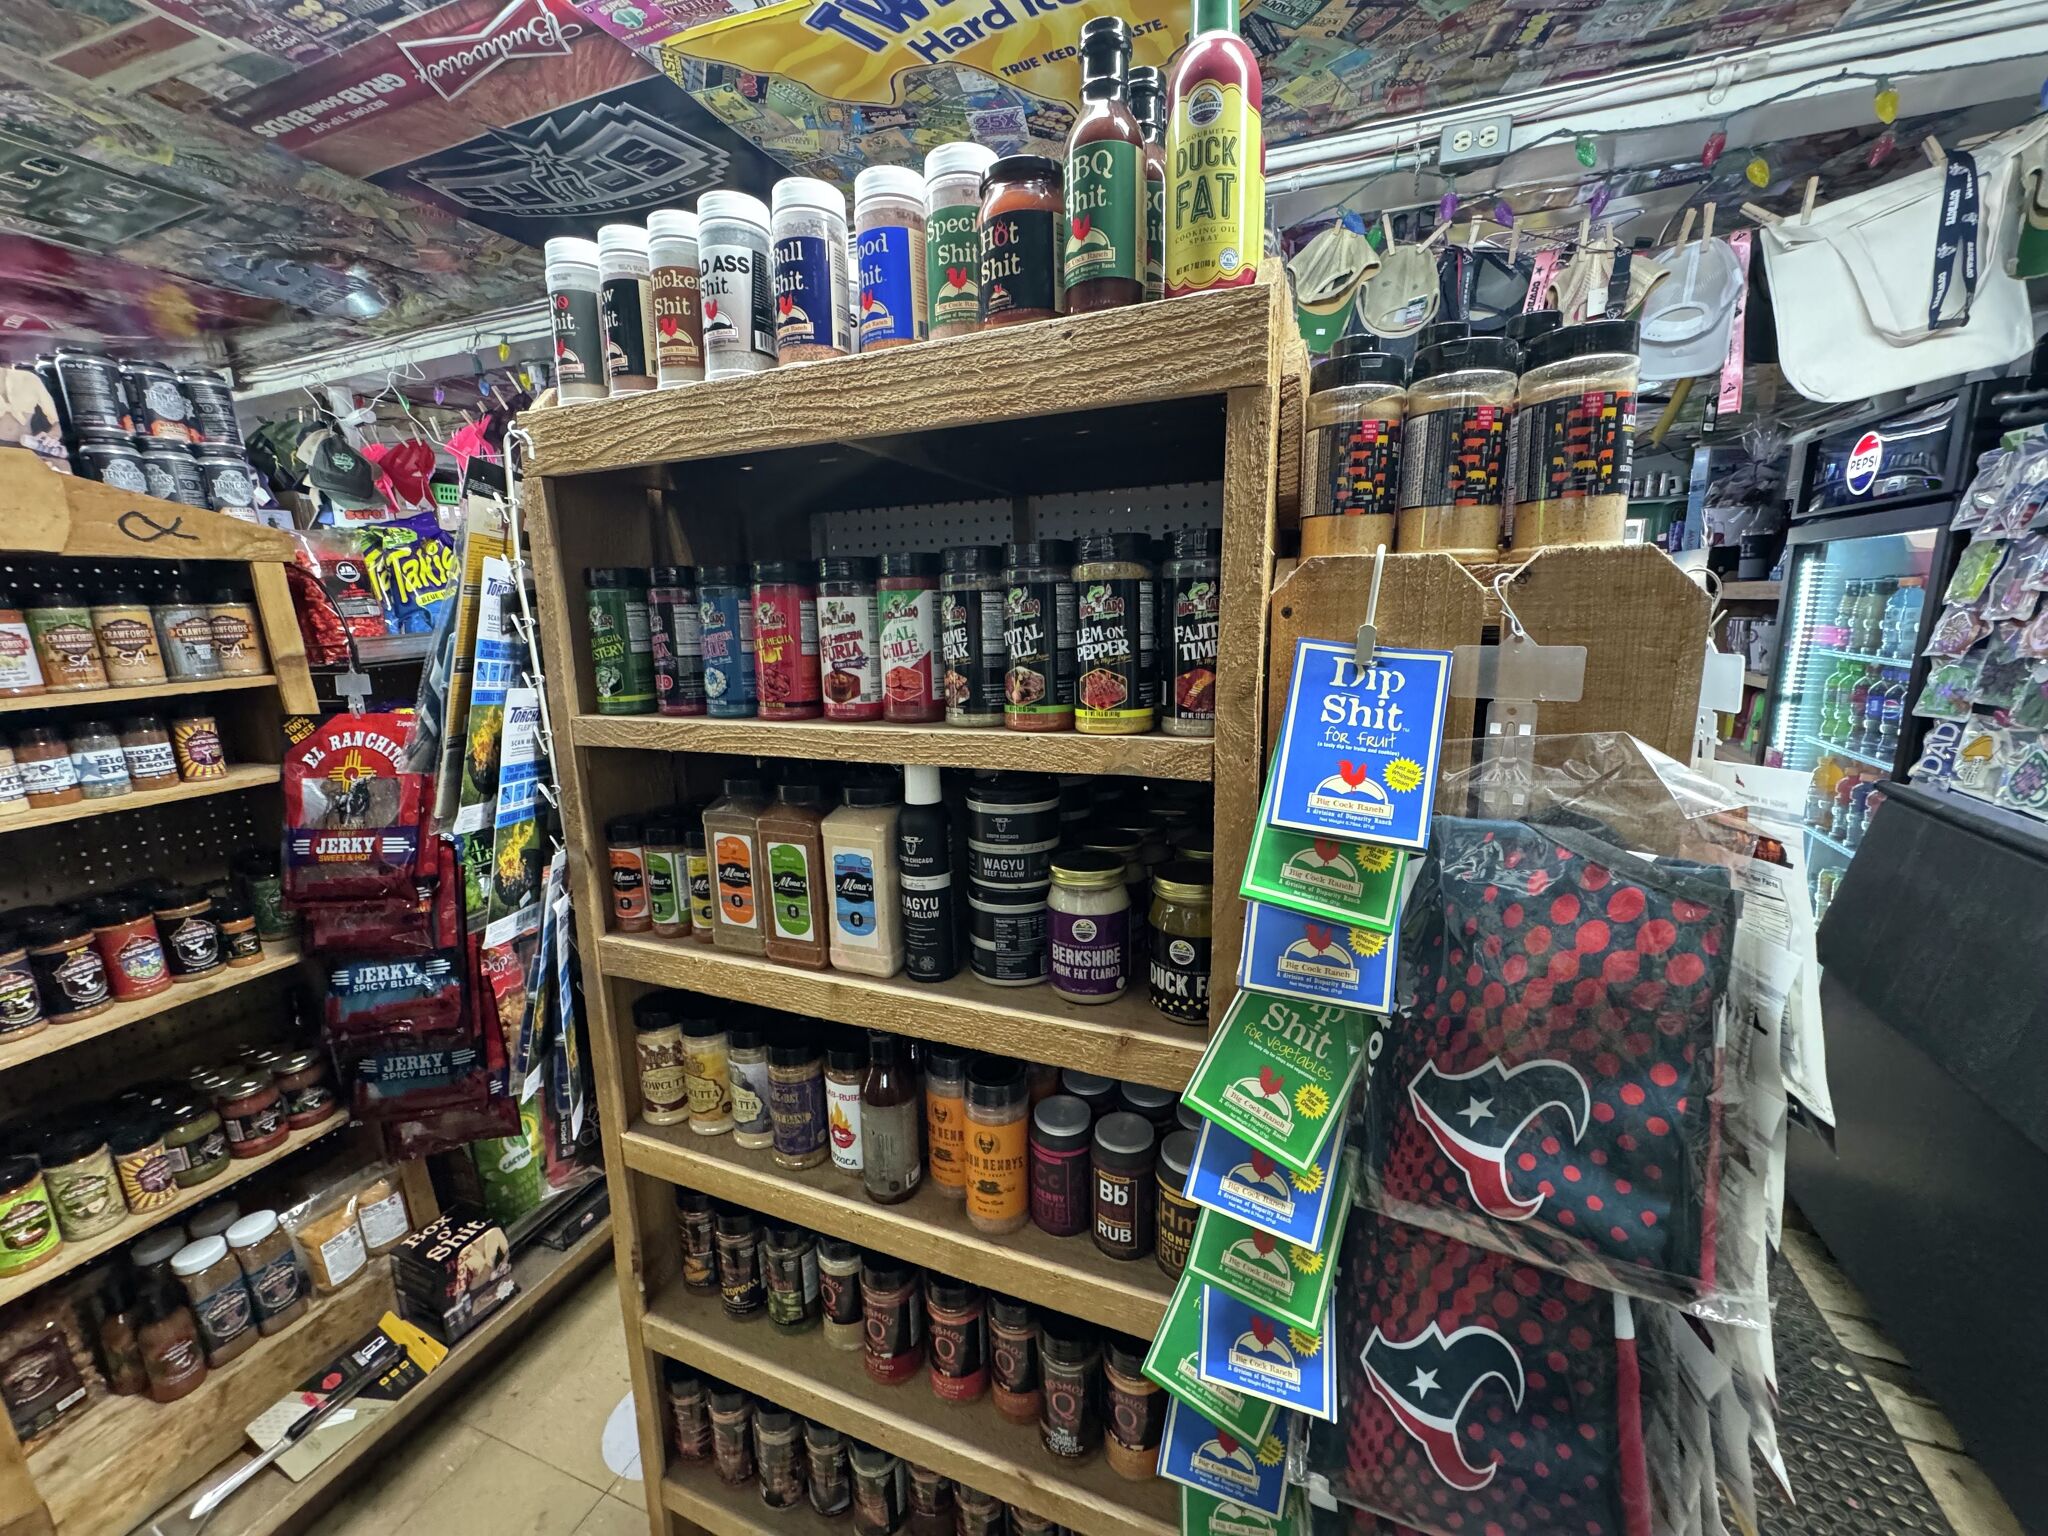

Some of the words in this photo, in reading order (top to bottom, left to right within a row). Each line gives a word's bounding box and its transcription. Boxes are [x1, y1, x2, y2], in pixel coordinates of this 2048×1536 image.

[907, 5, 1017, 64] Hard
[1129, 18, 1168, 38] ASTE.
[414, 11, 582, 84] Budweiser
[1000, 57, 1040, 78] TRUE
[1042, 44, 1078, 64] ICED
[337, 72, 408, 104] GRAB
[301, 95, 344, 117] SOME
[251, 109, 317, 138] BUDS
[974, 109, 1024, 131] 25X
[1185, 127, 1226, 143] GOURMET
[1176, 135, 1237, 180] DUCK
[1176, 172, 1237, 231] FAT
[926, 211, 978, 244] Speci
[1174, 226, 1217, 245] COOKING
[1220, 225, 1237, 234] OIL
[858, 232, 889, 260] ood
[1188, 234, 1219, 246] SPRAY
[712, 254, 750, 275] ASS
[980, 252, 1022, 287] Shit
[655, 296, 692, 317] Shit
[1850, 455, 1878, 471] PEPSI
[386, 541, 460, 604] Takis
[943, 627, 968, 648] RIME
[1003, 623, 1044, 647] TOTAL
[1174, 621, 1218, 644] FAJIT
[68, 654, 91, 667] SA
[119, 650, 149, 667] SA
[220, 644, 242, 660] SA
[821, 640, 864, 664] FURIA
[943, 642, 970, 661] TEAK
[1009, 640, 1038, 661] ALL
[1077, 639, 1131, 663] PEPPER
[1329, 656, 1406, 700] Dip
[1321, 692, 1403, 732] Shit
[284, 714, 311, 737] 100%
[289, 723, 317, 746] BEEF
[301, 744, 327, 770] EL
[1919, 722, 1961, 776] DAD
[97, 756, 124, 767] BIG
[1407, 767, 1419, 776] add
[1391, 770, 1416, 784] Whipped
[1391, 776, 1410, 788] Cream
[1316, 796, 1330, 808] Big
[1333, 799, 1354, 810] Cock
[1357, 802, 1384, 815] Ranch
[1313, 808, 1336, 818] division
[1345, 813, 1372, 824] Disparity
[1374, 817, 1392, 827] Ranch
[315, 836, 376, 855] JERKY
[318, 853, 345, 863] SWEET
[352, 853, 371, 862] HOT
[910, 856, 934, 866] CHICAGO
[983, 857, 1025, 872] WAGYU
[718, 866, 750, 880] Mona's
[774, 876, 806, 890] Mona's
[984, 869, 999, 878] BEEF
[1000, 869, 1025, 879] TALLOW
[1288, 868, 1302, 878] Big
[1304, 872, 1326, 885] Cock
[1327, 877, 1355, 893] Ranch
[836, 876, 873, 893] Mona's
[911, 909, 940, 919] TALLOW
[1051, 942, 1121, 968] BERKSHIRE
[354, 961, 418, 985] JERKY
[1052, 963, 1073, 977] PORK
[1074, 967, 1089, 980] FAT
[1090, 964, 1121, 981] (LARD)
[1149, 959, 1190, 999] DUCK
[1285, 960, 1300, 971] Big
[1302, 963, 1322, 975] Cock
[1324, 966, 1351, 980] Ranch
[353, 981, 387, 993] SPICY
[390, 979, 421, 990] BLUE
[1261, 1001, 1334, 1061] Shit
[382, 1069, 416, 1081] SPICY
[420, 1066, 449, 1077] BLUE
[383, 1053, 444, 1073] JERKY
[1229, 1091, 1243, 1102] Big
[1243, 1098, 1262, 1112] Cock
[1262, 1108, 1287, 1130] Ranch
[1099, 1179, 1128, 1206] Bb
[1242, 1186, 1262, 1200] Cock
[401, 1215, 454, 1249] Box
[426, 1218, 487, 1262] Shit
[1097, 1220, 1132, 1243] RUB
[1160, 1228, 1191, 1248] HONE
[1160, 1245, 1186, 1268] RU
[1242, 1263, 1262, 1278] Cock
[1264, 1272, 1287, 1290] Ranch
[1235, 1353, 1248, 1364] Big
[1249, 1357, 1268, 1371] Cock
[1269, 1363, 1294, 1379] Ranch
[1052, 1391, 1076, 1421] Q
